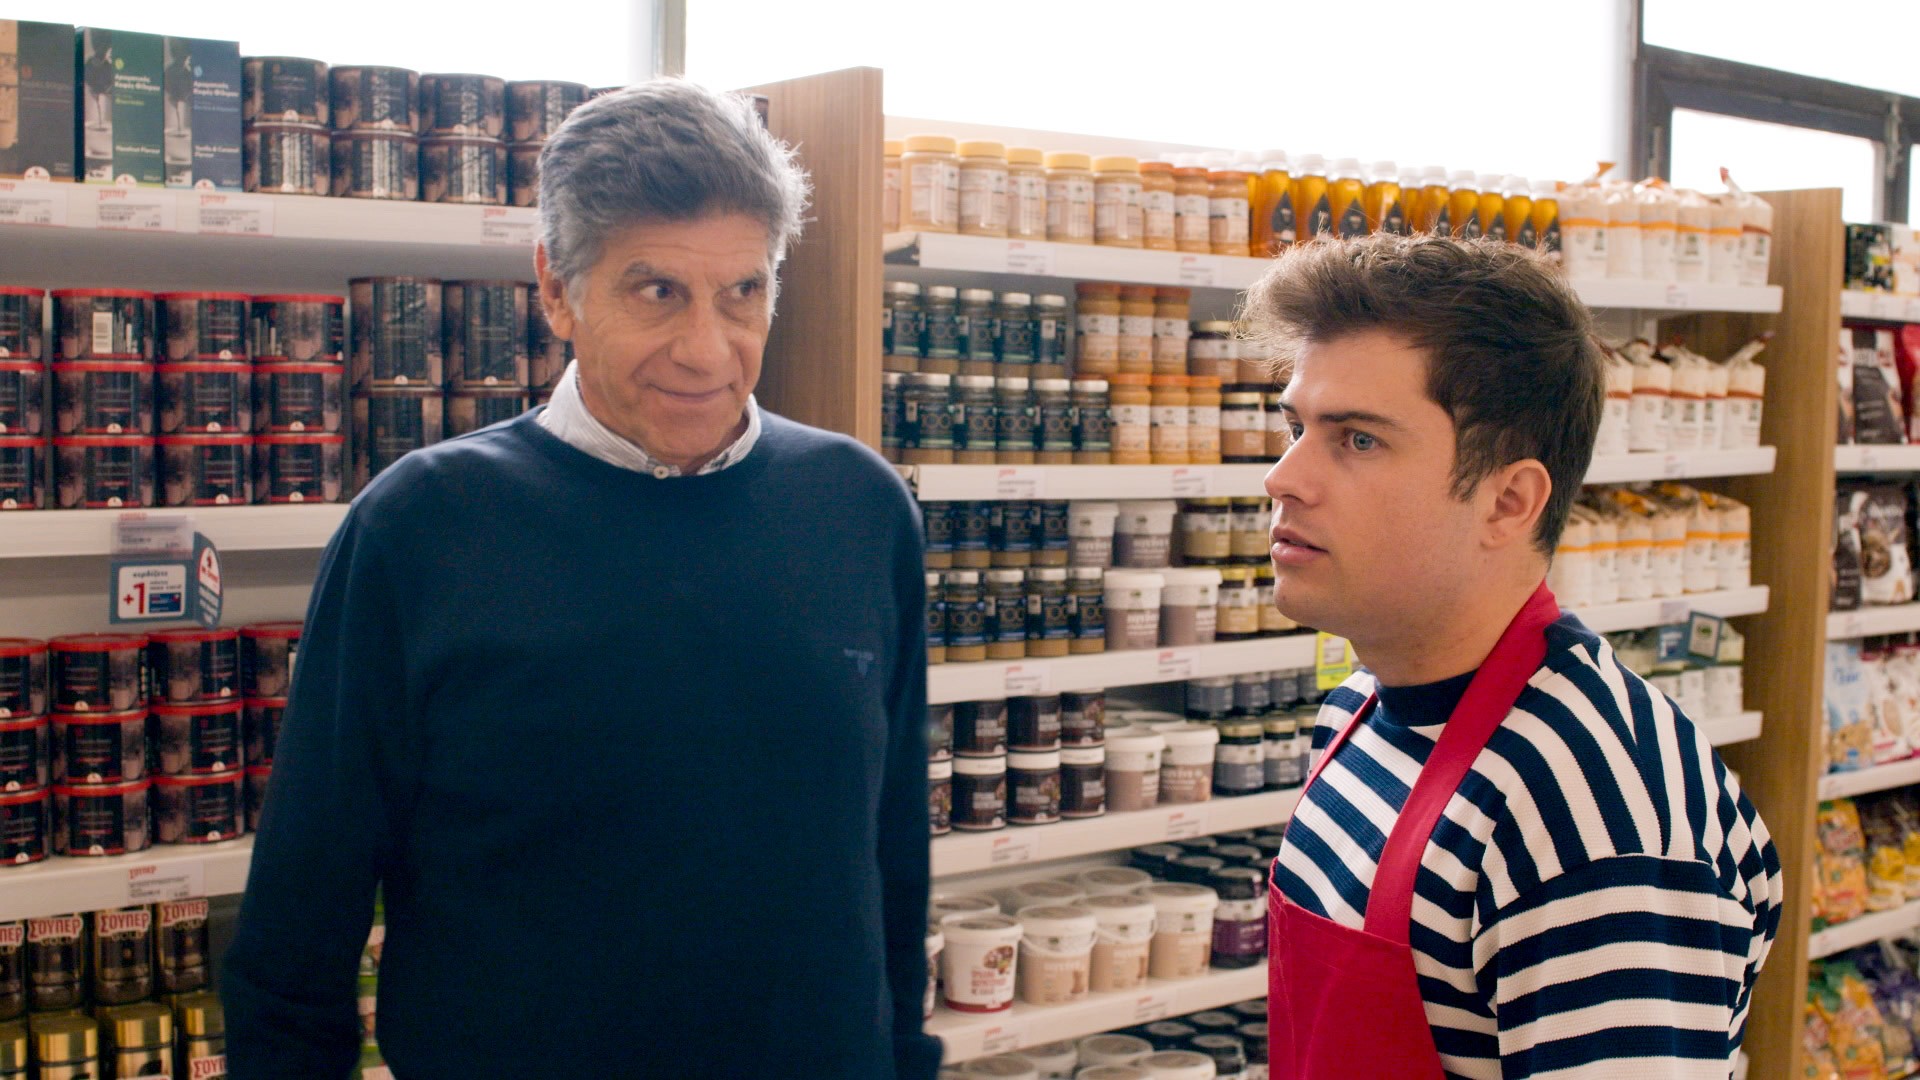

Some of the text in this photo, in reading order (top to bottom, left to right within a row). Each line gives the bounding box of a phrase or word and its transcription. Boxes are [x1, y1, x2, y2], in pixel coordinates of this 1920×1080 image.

[100, 912, 149, 934] ΣΟΥΠΕΡ
[162, 901, 208, 924] ΣΟΥΠΕΡ
[0, 927, 23, 944] ΠΕΡ
[29, 918, 81, 940] ΣΟΥΠΕΡ
[194, 1056, 228, 1079] ΣΟΥΠ
